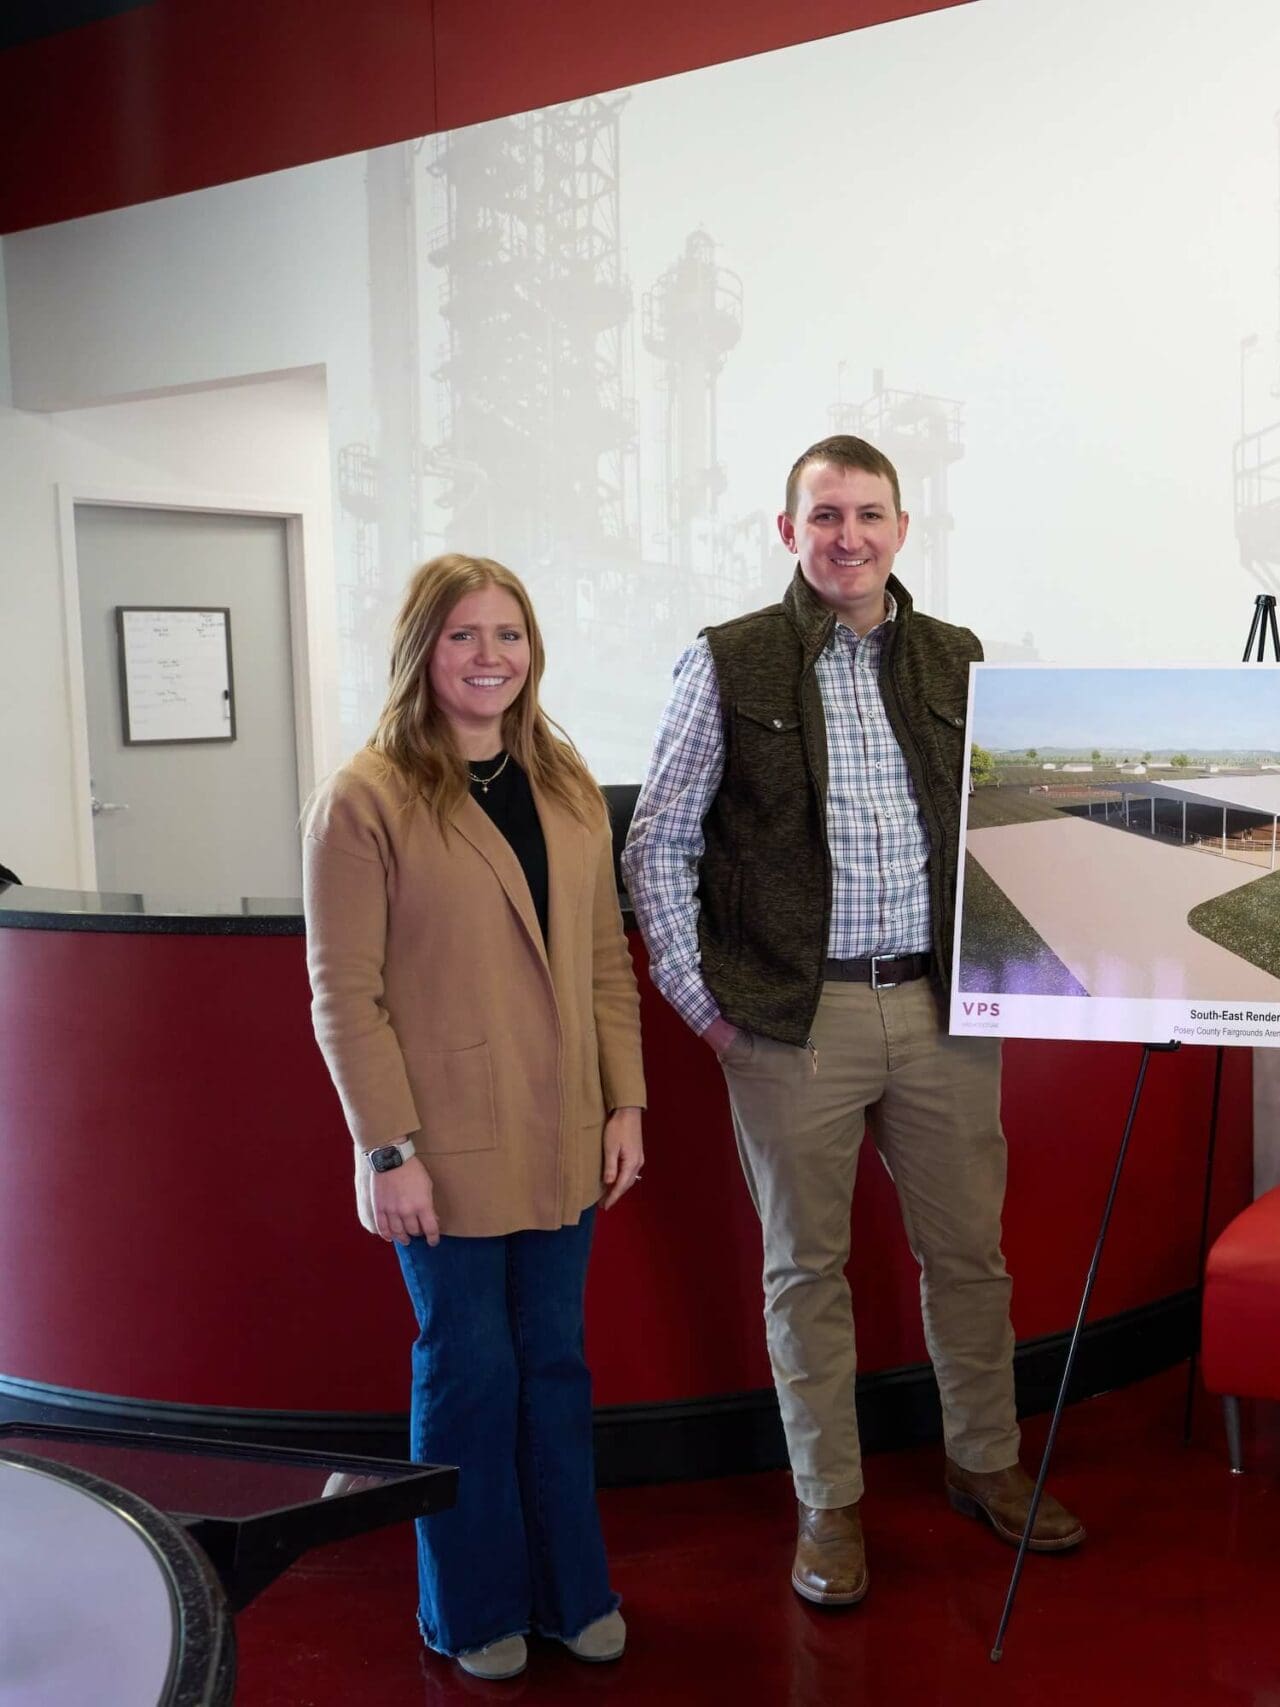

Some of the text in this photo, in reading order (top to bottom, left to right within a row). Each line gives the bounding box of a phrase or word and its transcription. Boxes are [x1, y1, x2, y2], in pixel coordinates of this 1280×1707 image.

[963, 1002, 1000, 1016] VPS
[1190, 1009, 1243, 1020] South-East
[1173, 1025, 1195, 1035] Posey
[1196, 1026, 1220, 1037] County
[1222, 1027, 1263, 1038] Fairgrounds
